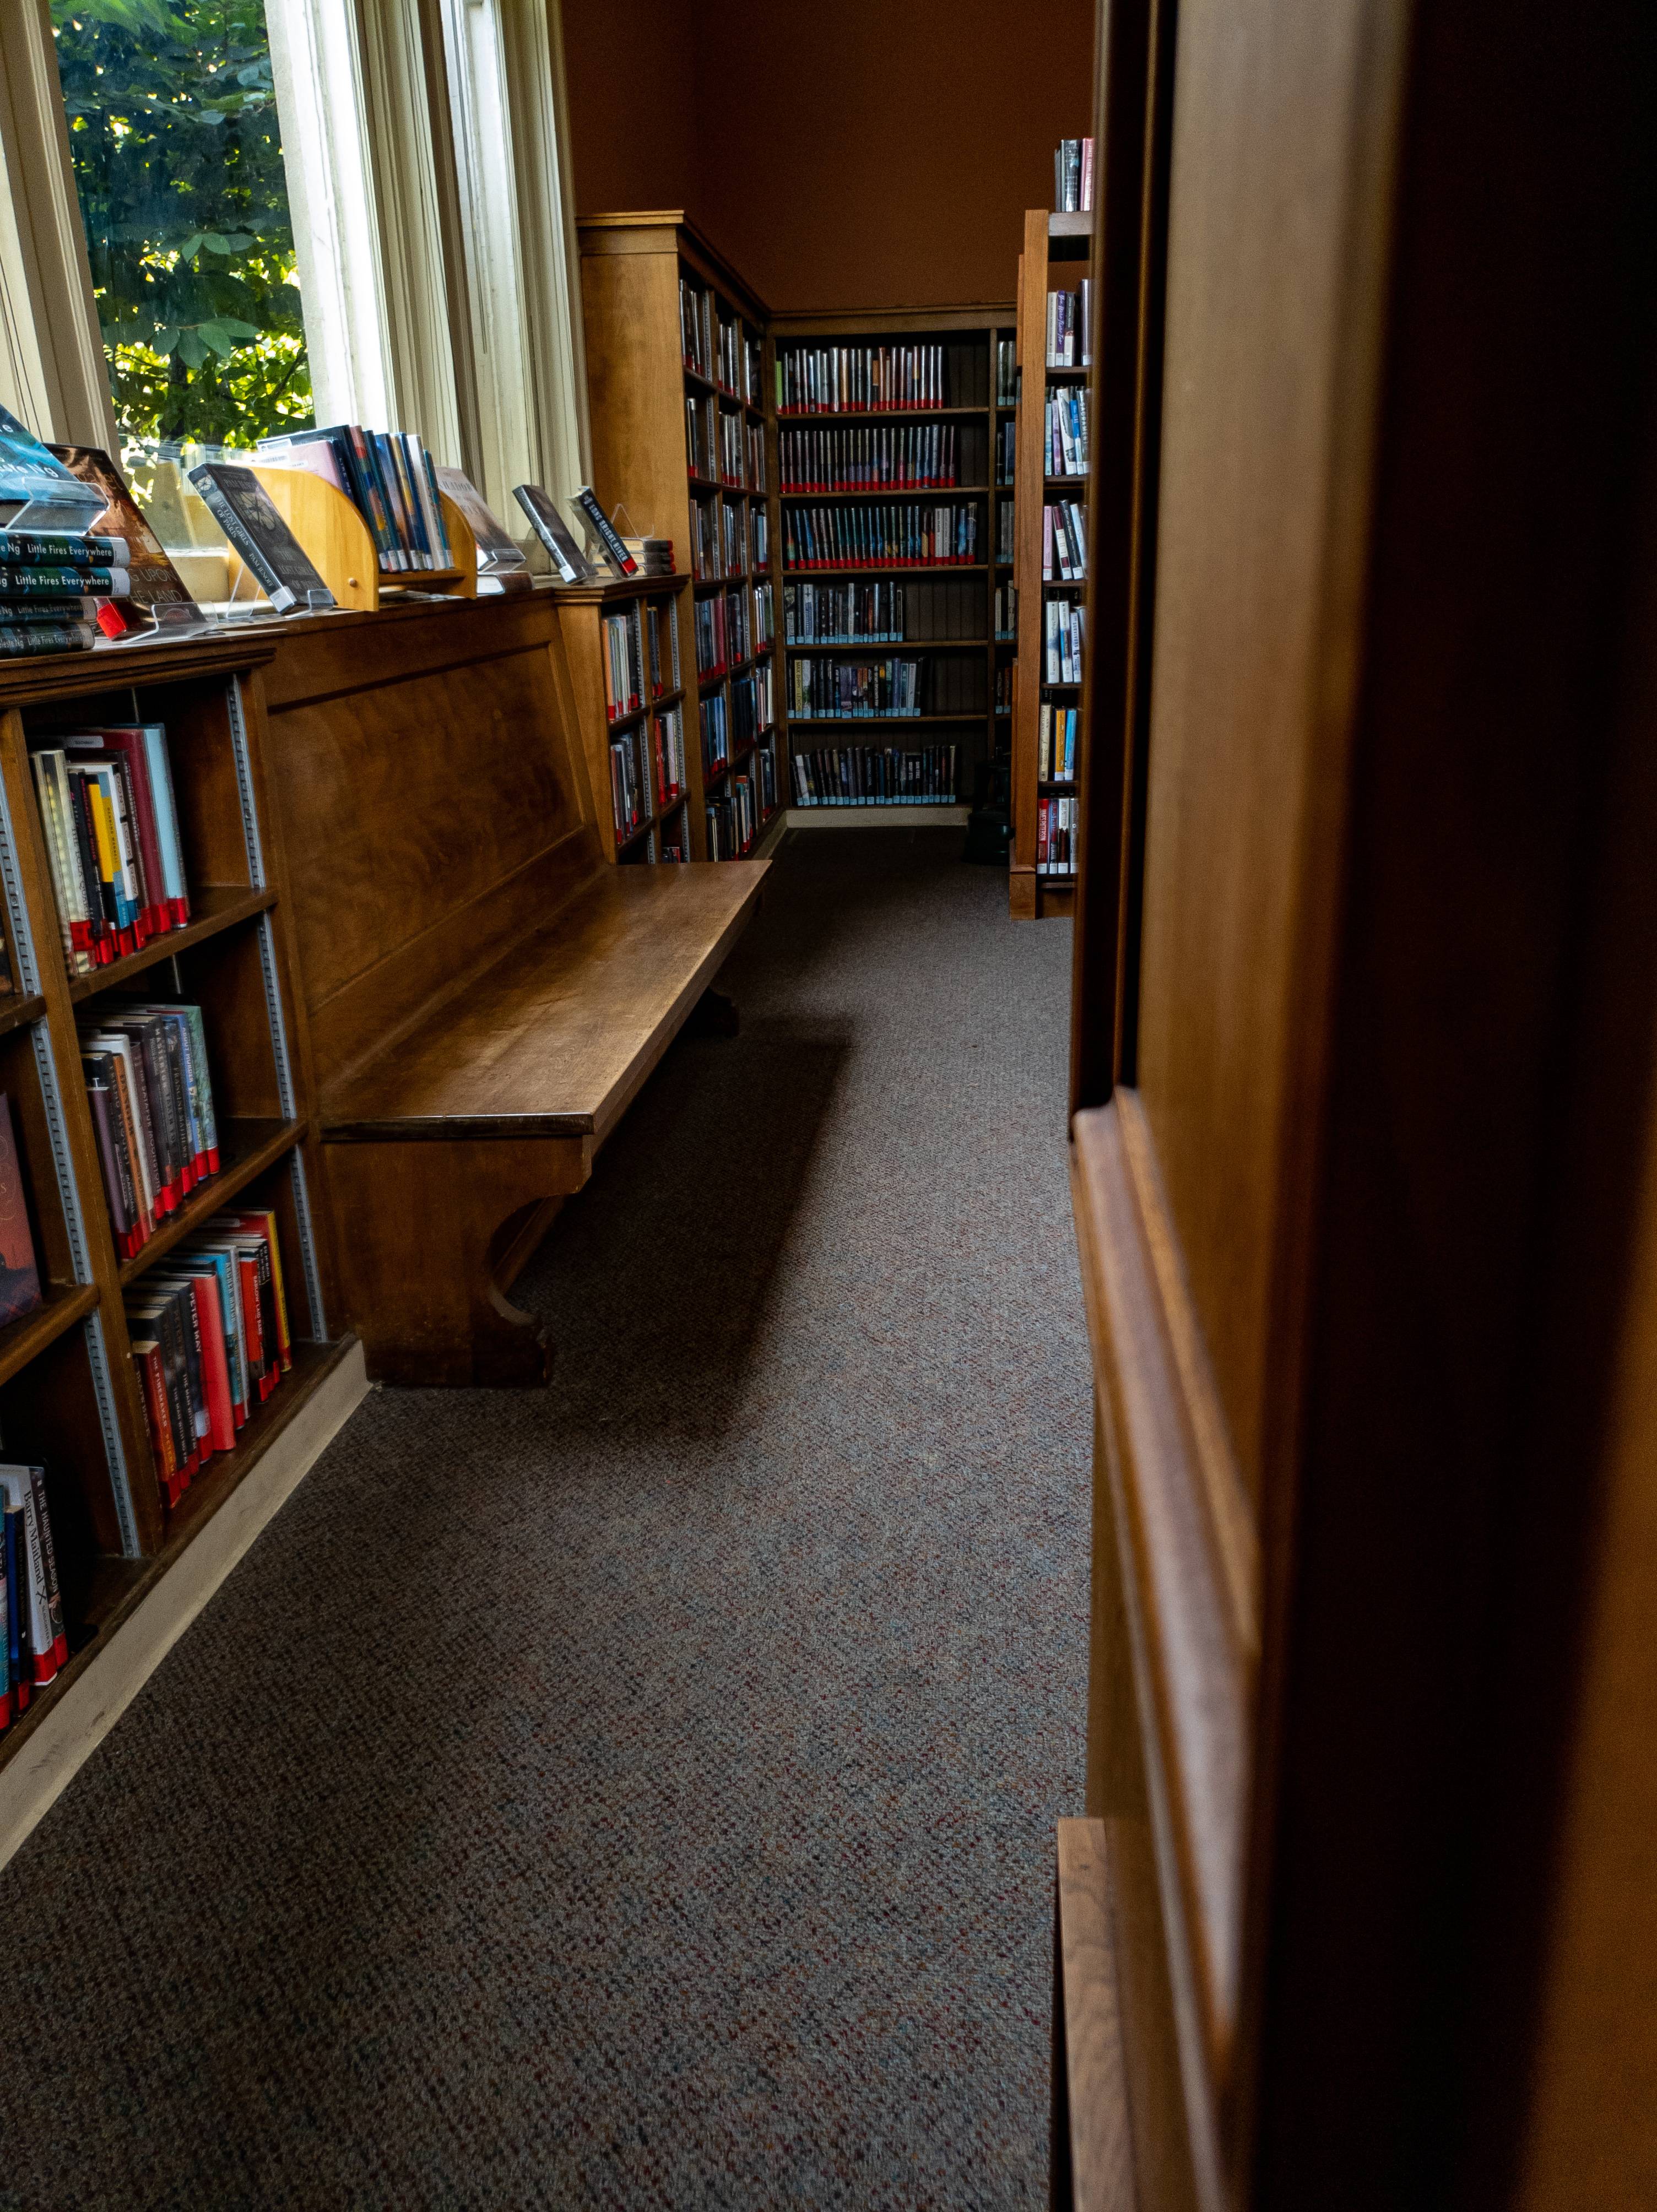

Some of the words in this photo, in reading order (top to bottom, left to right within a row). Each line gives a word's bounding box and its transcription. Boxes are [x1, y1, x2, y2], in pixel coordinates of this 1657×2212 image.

[26, 463, 59, 478] Ng
[215, 496, 225, 509] THE
[223, 509, 237, 525] LOST
[235, 525, 250, 546] GIRLS
[217, 509, 225, 518] OF
[223, 521, 238, 539] PARIS
[8, 543, 20, 555] Ng
[27, 543, 46, 555] Little
[49, 545, 67, 555] Fires
[69, 546, 112, 557] Everywhere
[248, 553, 259, 567] PAM
[15, 574, 37, 585] Little
[39, 576, 59, 585] Fires
[62, 576, 109, 587] Everywhere
[138, 568, 178, 582] UPON
[148, 590, 182, 603] LAND
[1038, 821, 1047, 841] PATTERSON
[186, 1053, 194, 1083] MURDER
[118, 1113, 129, 1164] REQUEST
[147, 1130, 161, 1193] MOONSTONE
[188, 1292, 198, 1329] PETER
[193, 1330, 202, 1353] MAY
[24, 1489, 36, 1530] Barry
[38, 1489, 46, 1509] THE
[41, 1510, 54, 1557] HAUNTED
[29, 1527, 45, 1585] Maitland
[48, 1557, 58, 1592] SEASON
